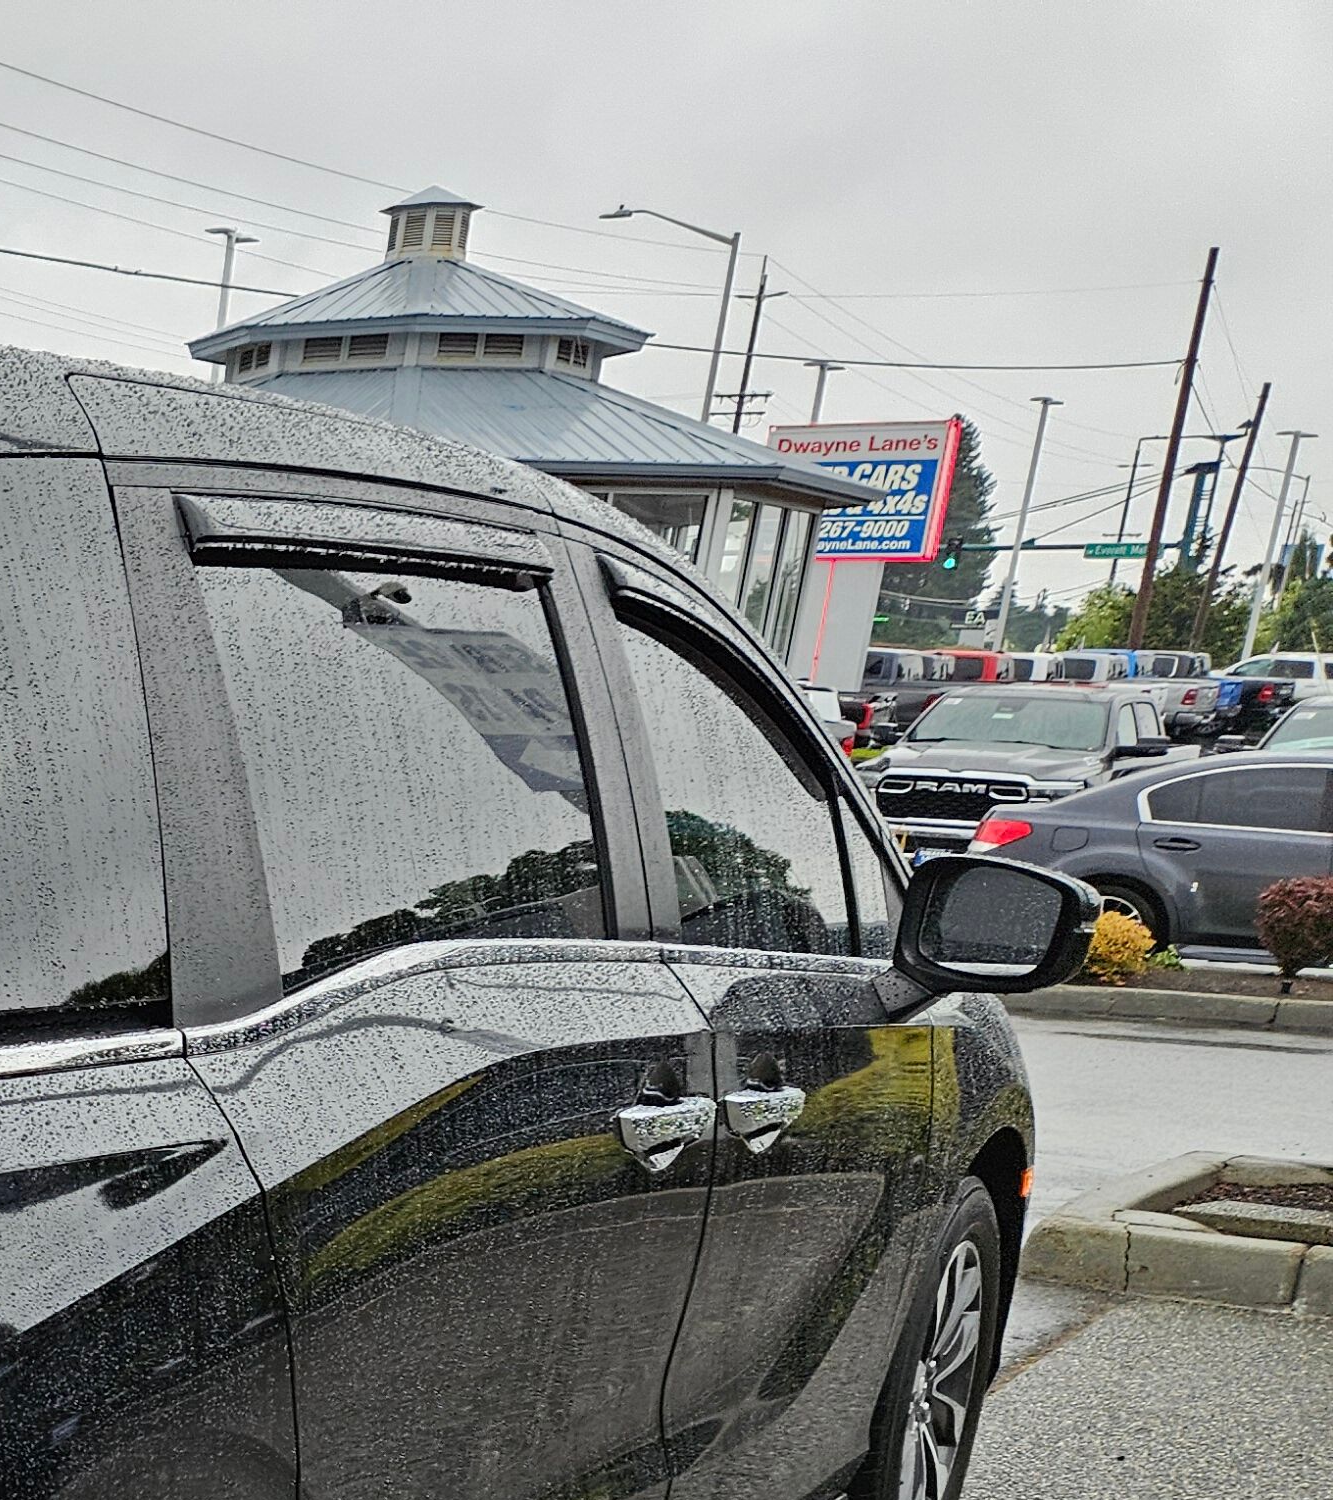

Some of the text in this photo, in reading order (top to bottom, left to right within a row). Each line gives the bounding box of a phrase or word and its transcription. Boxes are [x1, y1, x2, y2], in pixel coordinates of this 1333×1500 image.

[777, 434, 939, 456] Dwayne Lane's
[852, 463, 922, 491] CARS
[818, 520, 910, 538] 267-9000
[817, 538, 911, 552] ayneLane.com
[915, 781, 987, 794] RAM
